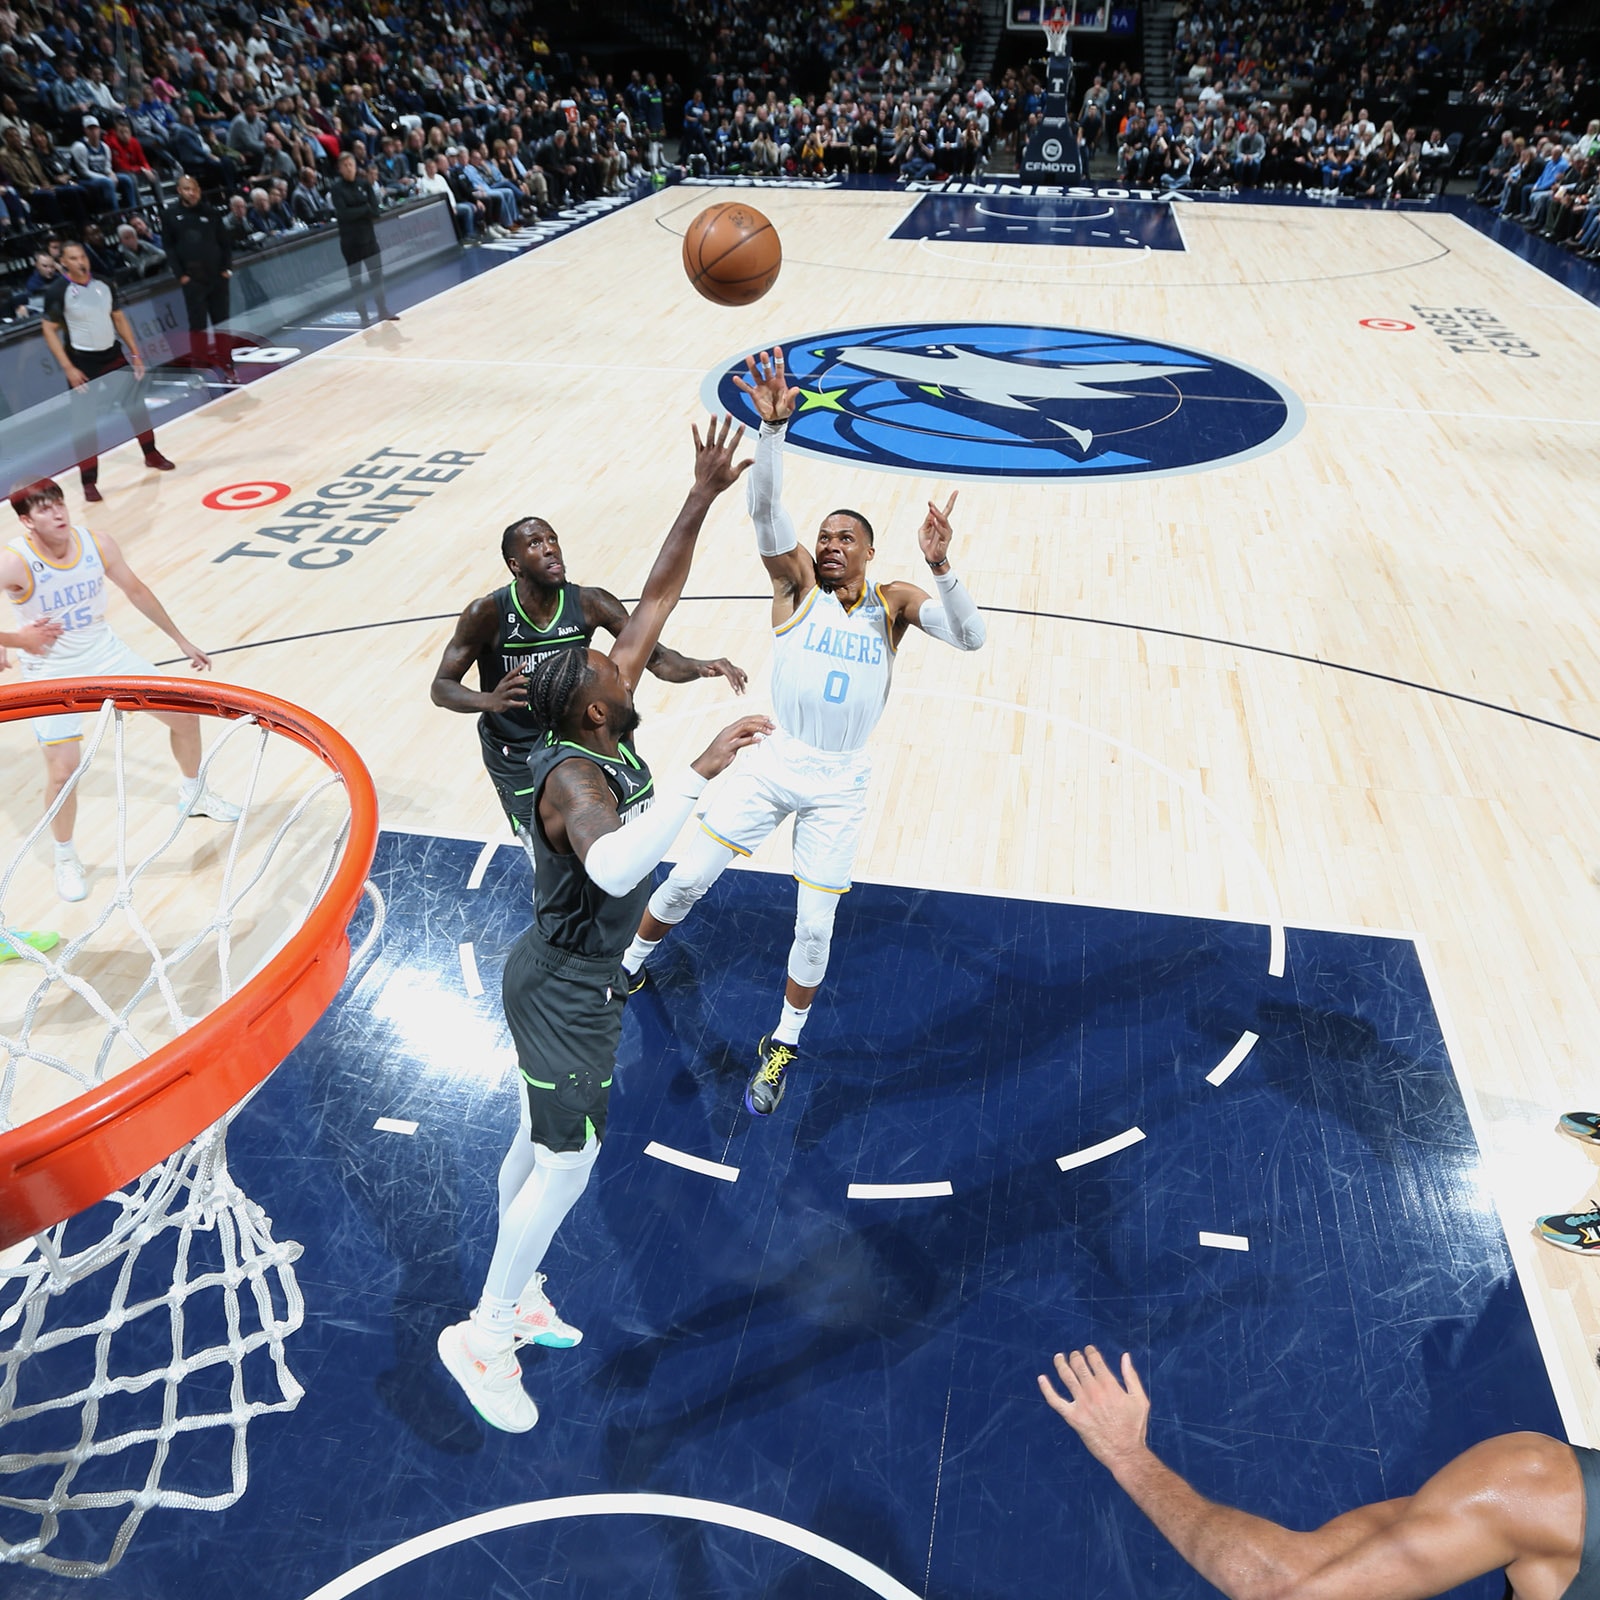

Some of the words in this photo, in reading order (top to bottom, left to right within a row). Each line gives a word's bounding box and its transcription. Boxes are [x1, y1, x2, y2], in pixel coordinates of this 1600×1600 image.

[1025, 161, 1076, 173] CFMOTO
[905, 182, 1194, 201] MINNESOTA
[1410, 304, 1490, 354] TARGET
[1454, 307, 1541, 358] CENTER
[211, 446, 422, 564] TARGET
[287, 450, 487, 570] CENTER
[62, 606, 93, 631] 15
[803, 623, 883, 665] LAKERS
[823, 670, 850, 704] 0
